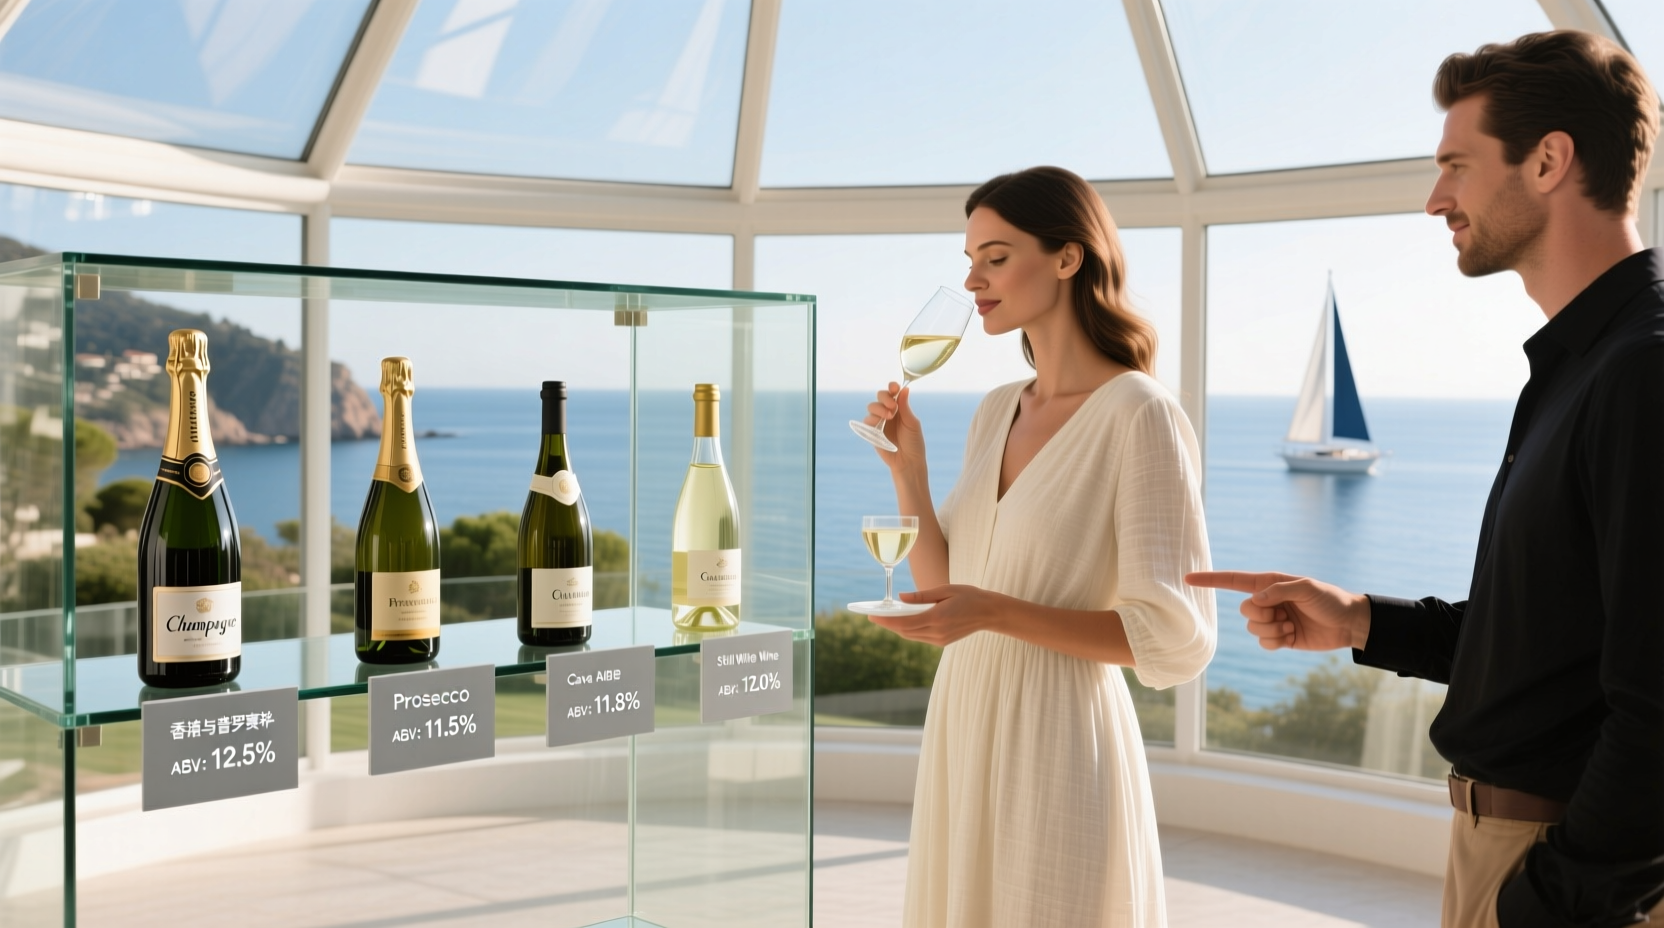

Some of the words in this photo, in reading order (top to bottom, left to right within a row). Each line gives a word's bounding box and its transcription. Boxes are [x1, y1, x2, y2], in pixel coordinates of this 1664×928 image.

[567, 673, 593, 686] Cava
[393, 689, 470, 710] Prosecco
[567, 705, 592, 719] ABV:
[594, 691, 640, 714] 11.8%
[392, 727, 421, 743] ABV:
[425, 713, 477, 738] 11.5%
[170, 757, 207, 775] ABV:
[211, 740, 276, 769] 12.5%
